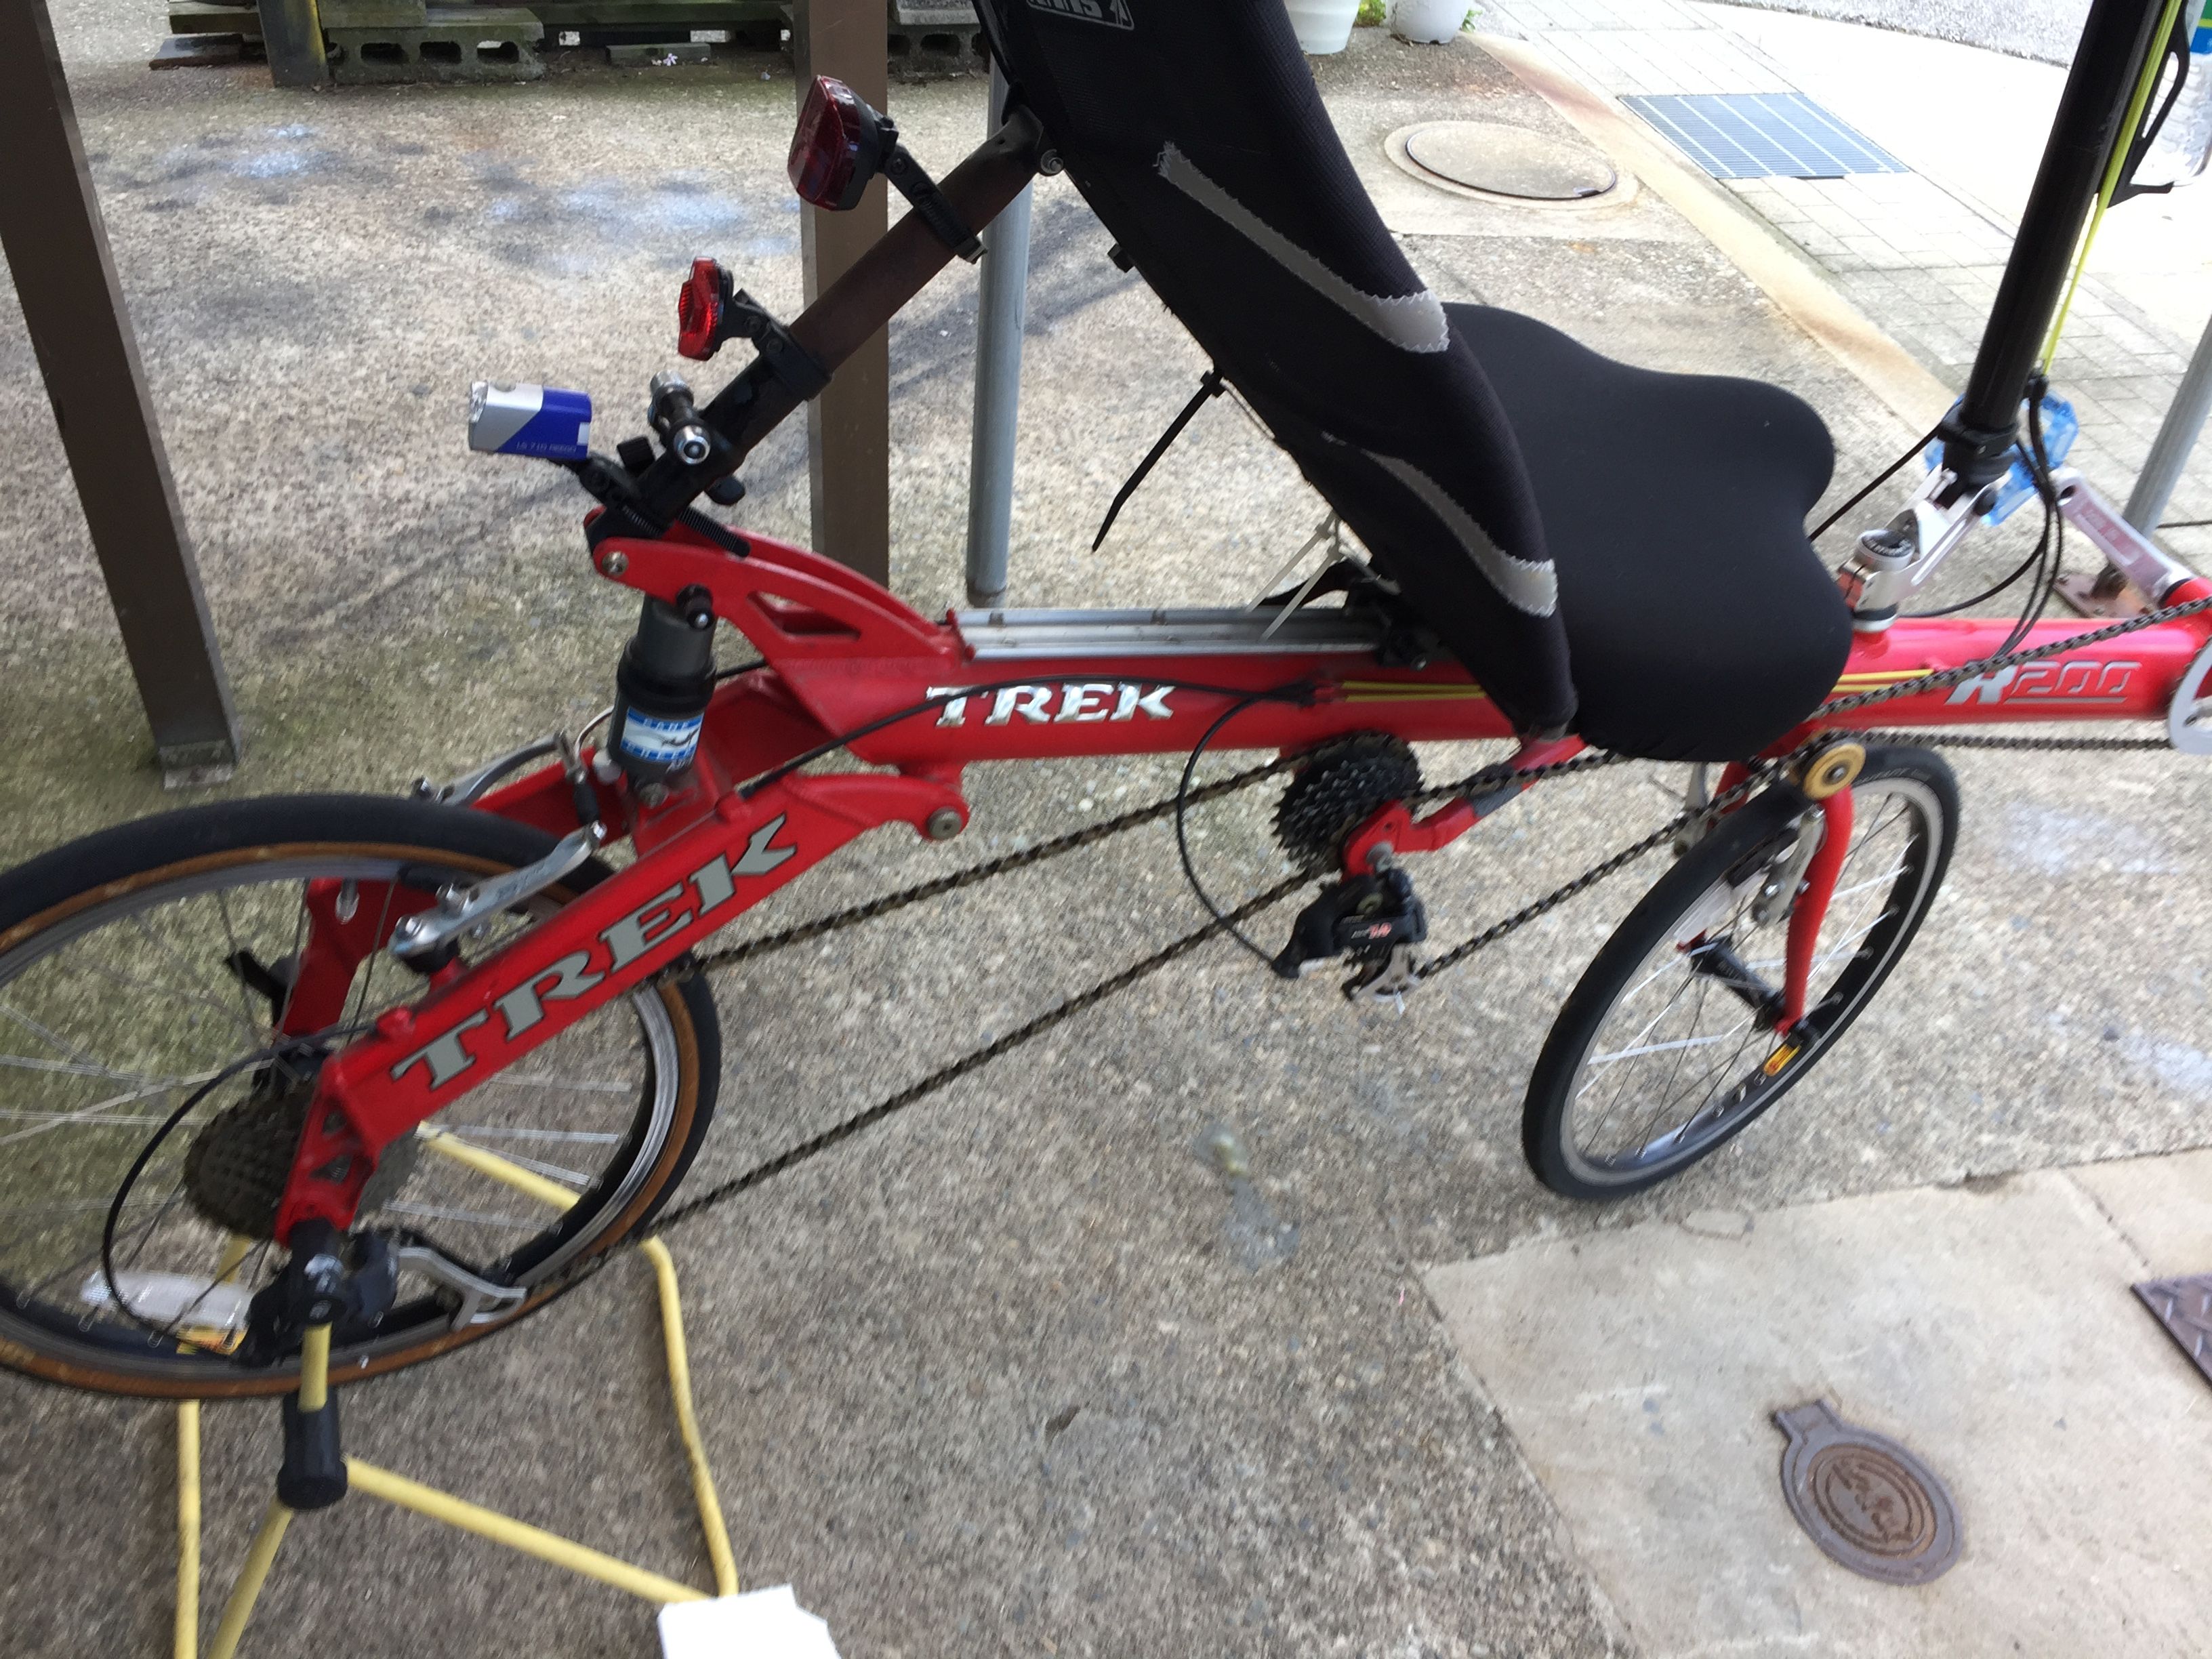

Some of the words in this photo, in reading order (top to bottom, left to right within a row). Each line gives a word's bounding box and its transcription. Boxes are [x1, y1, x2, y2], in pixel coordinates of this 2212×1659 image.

[926, 682, 1175, 727] TREK
[1944, 659, 2142, 705] R200
[390, 813, 798, 1090] TREK
